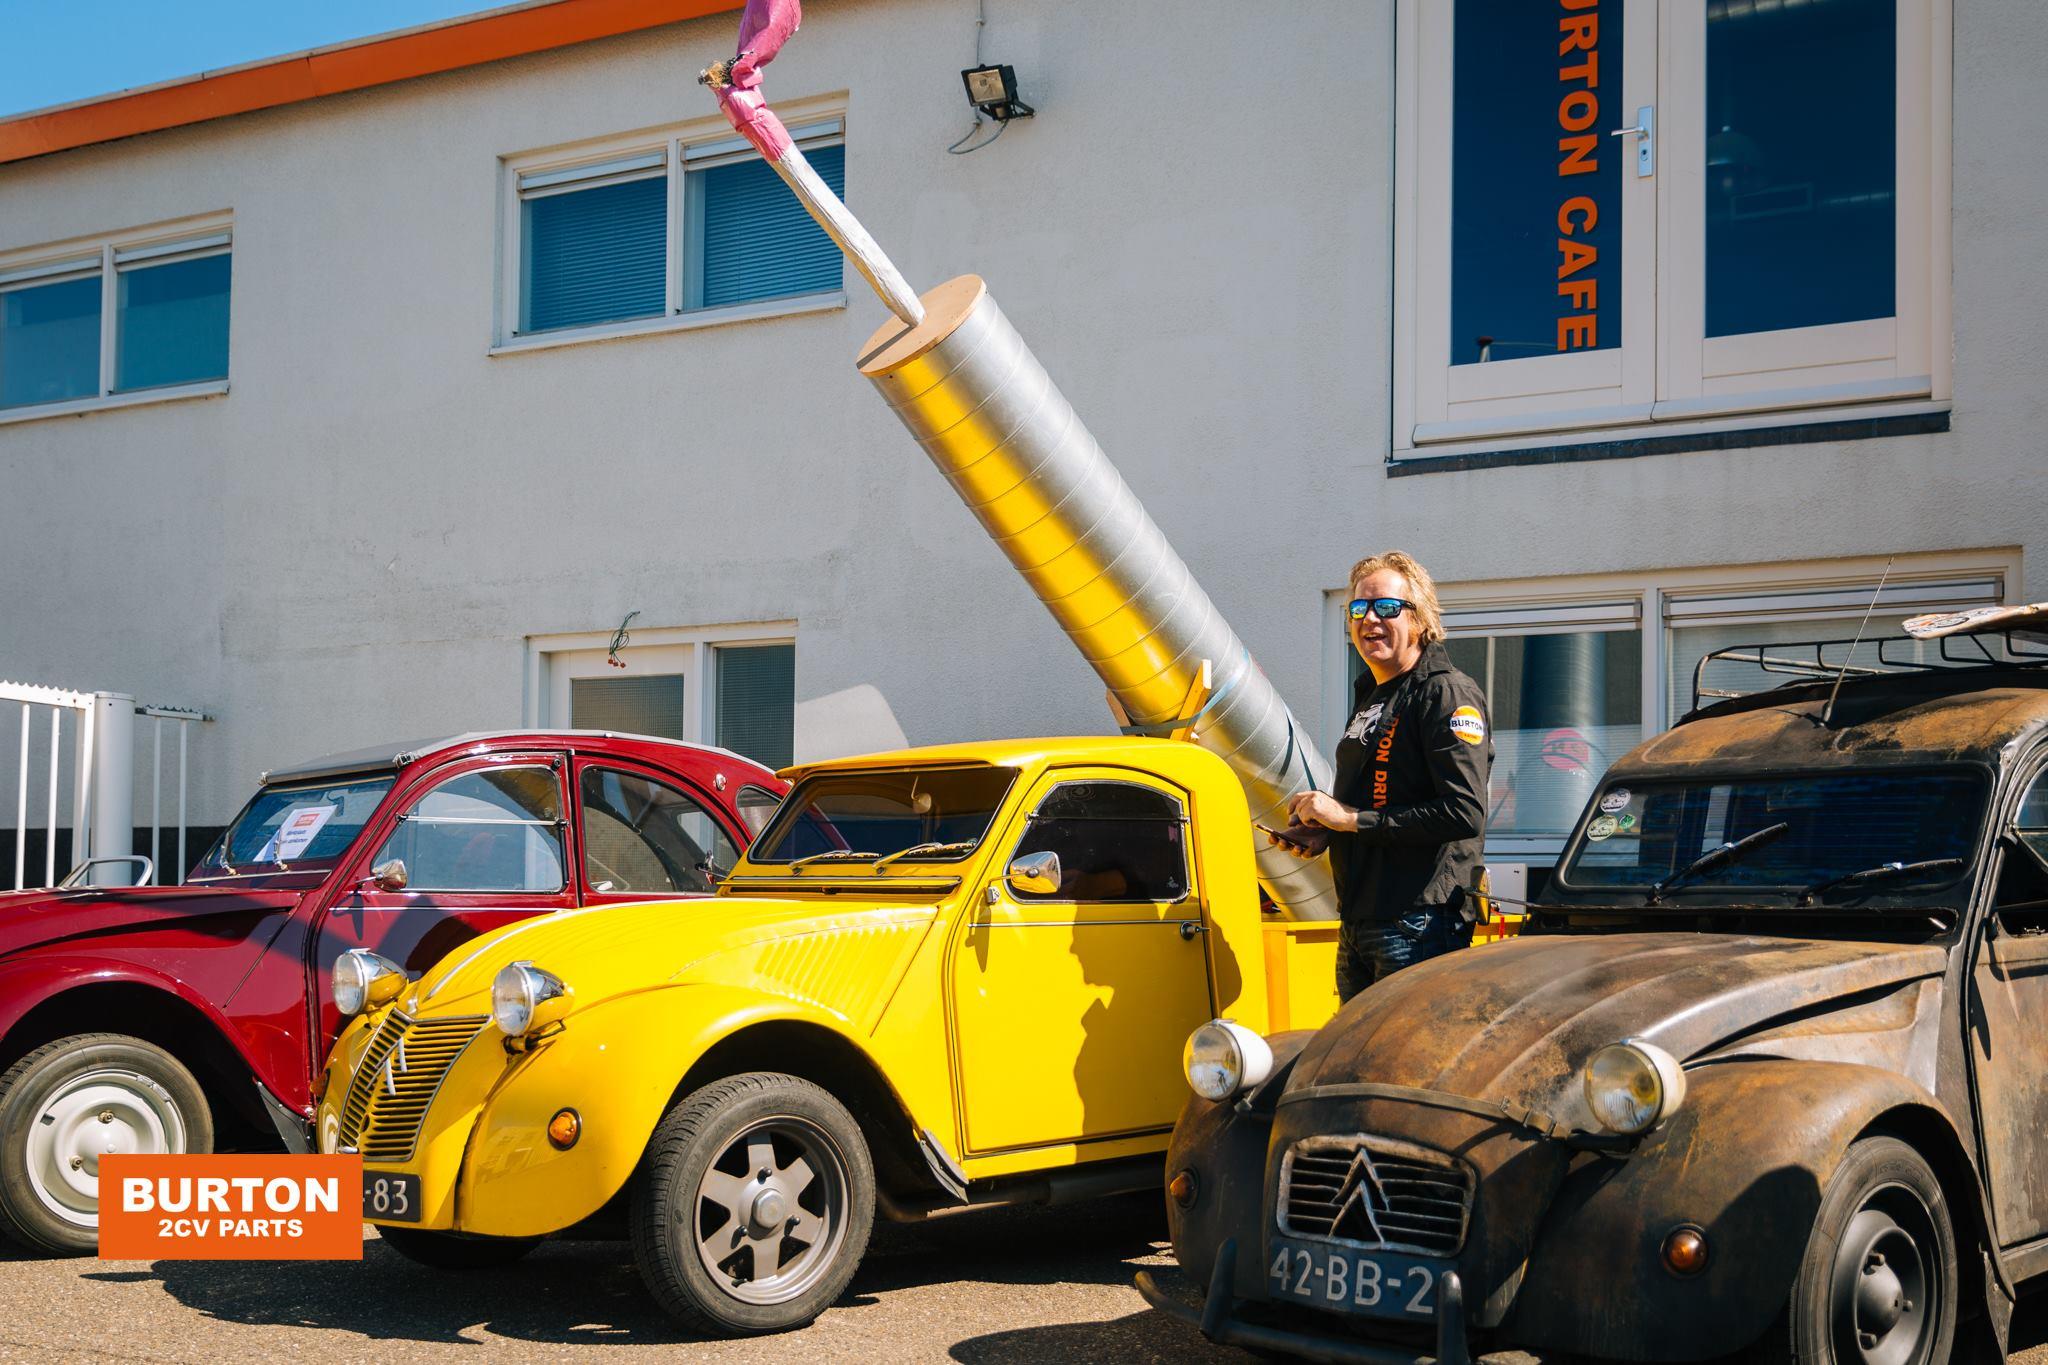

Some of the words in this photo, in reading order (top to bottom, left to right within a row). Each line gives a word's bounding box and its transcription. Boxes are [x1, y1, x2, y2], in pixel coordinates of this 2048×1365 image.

[1558, 0, 1599, 177] RTON
[1557, 196, 1598, 351] CAFE
[363, 1178, 408, 1214] -83
[1270, 1247, 1447, 1314] 42-BB-2
